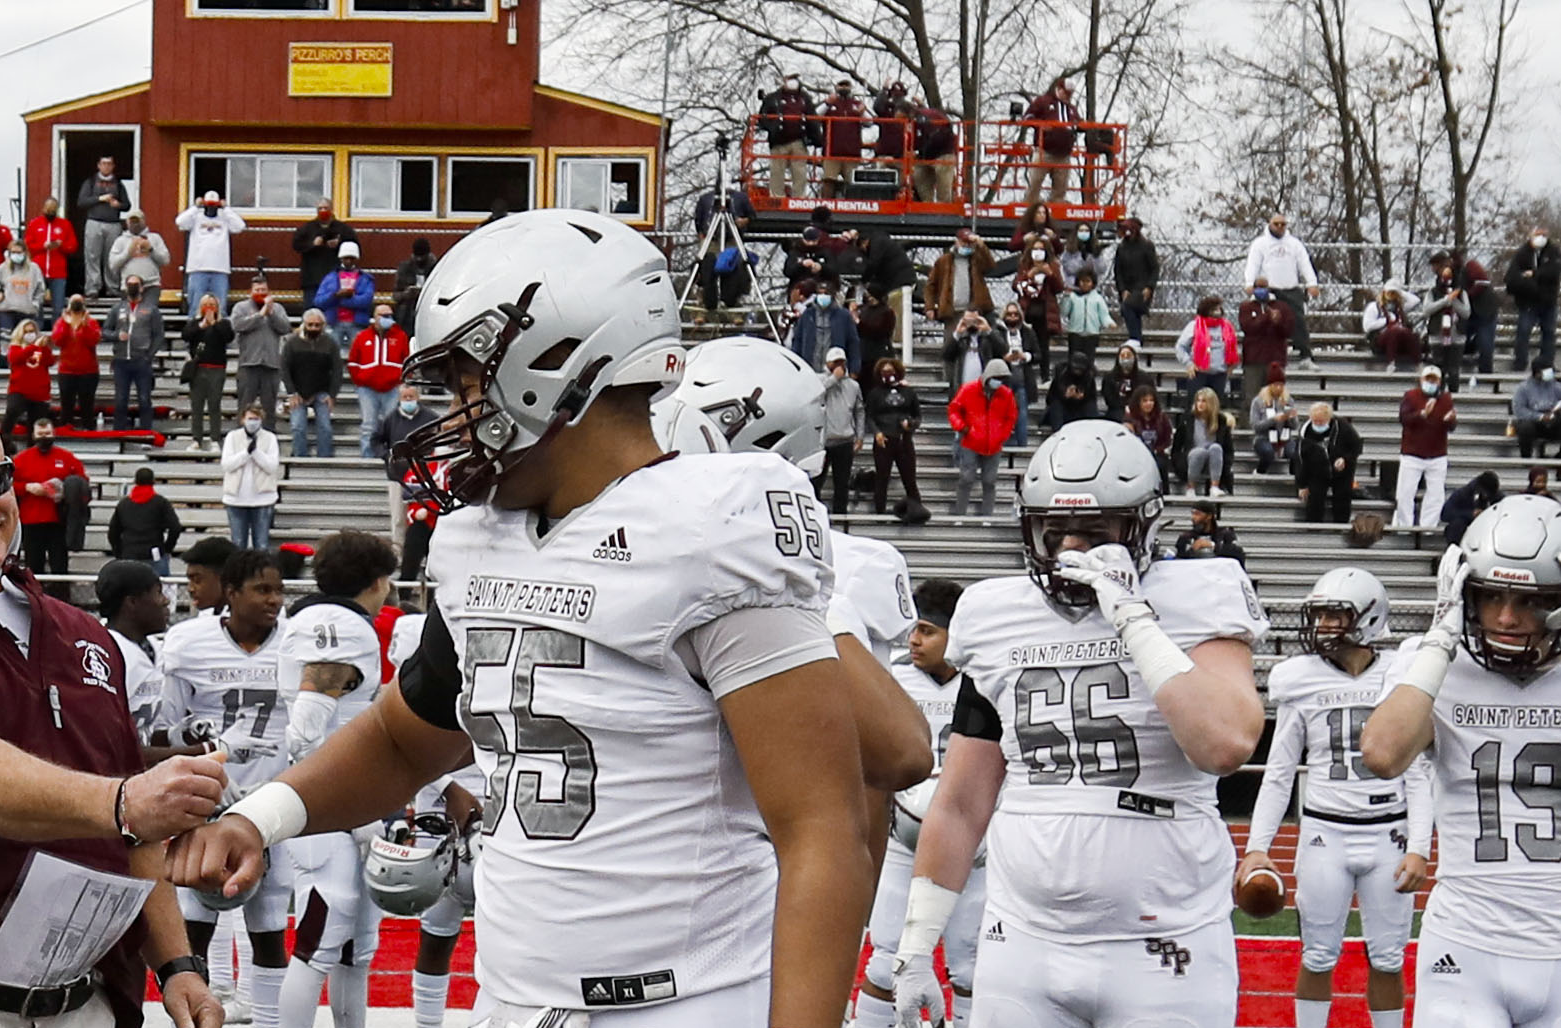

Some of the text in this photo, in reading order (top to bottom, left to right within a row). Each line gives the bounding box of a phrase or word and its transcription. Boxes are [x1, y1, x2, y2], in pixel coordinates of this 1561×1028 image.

[355, 48, 391, 61] PERCH
[837, 201, 879, 212] RENTALS
[1054, 497, 1092, 506] Riddell
[765, 490, 824, 560] 55
[1493, 569, 1530, 582] Riddell
[465, 578, 593, 618] SAINT PETER'S
[312, 623, 339, 650] 31
[1009, 642, 1058, 667] SAINT
[1014, 661, 1141, 789] 66
[1454, 706, 1511, 727] SAINT
[456, 626, 598, 841] 55
[1471, 741, 1561, 862] 19
[1431, 965, 1462, 975] adidas
[622, 987, 636, 999] XL
